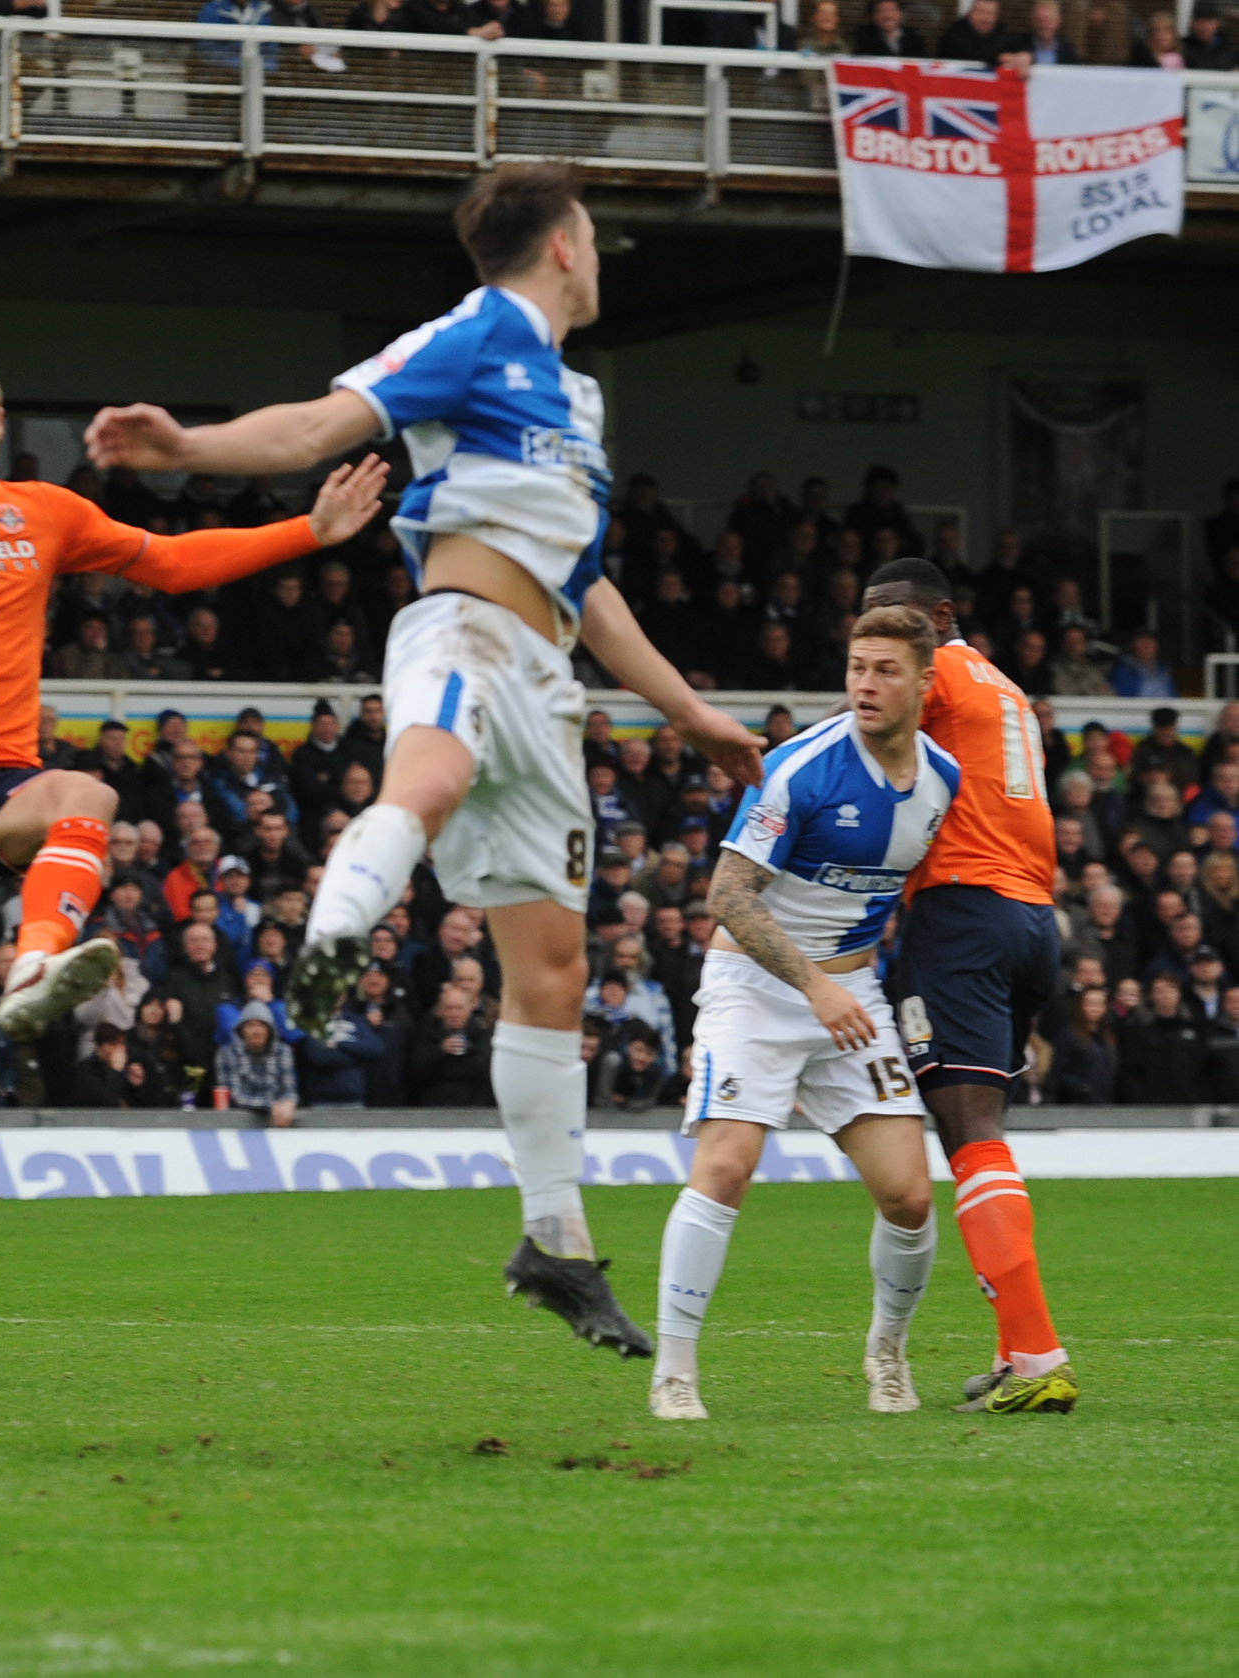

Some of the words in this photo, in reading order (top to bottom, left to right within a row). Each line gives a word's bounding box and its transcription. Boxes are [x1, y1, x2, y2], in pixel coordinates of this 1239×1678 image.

[851, 126, 1002, 175] BRISTOL
[1034, 125, 1170, 172] ROVERS
[566, 828, 586, 888] 8
[866, 1056, 913, 1102] 15
